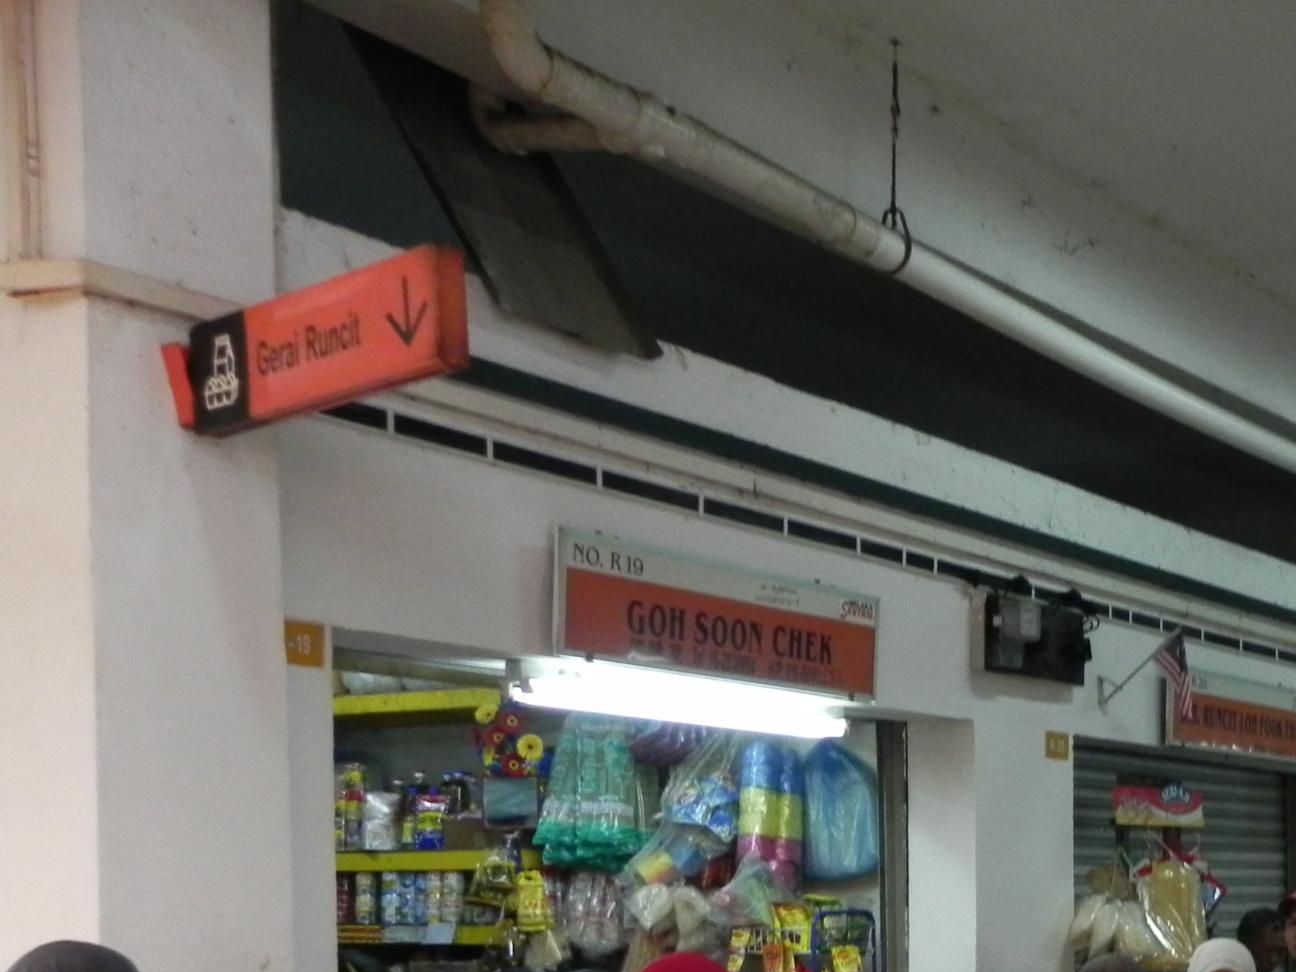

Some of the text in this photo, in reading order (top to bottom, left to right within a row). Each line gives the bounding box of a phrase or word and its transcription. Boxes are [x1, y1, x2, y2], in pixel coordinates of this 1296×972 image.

[257, 311, 361, 376] Gerai Runcit
[573, 543, 604, 568] NO.
[627, 600, 685, 641] GOH
[695, 611, 762, 653] SOON
[772, 626, 833, 664] CHEK
